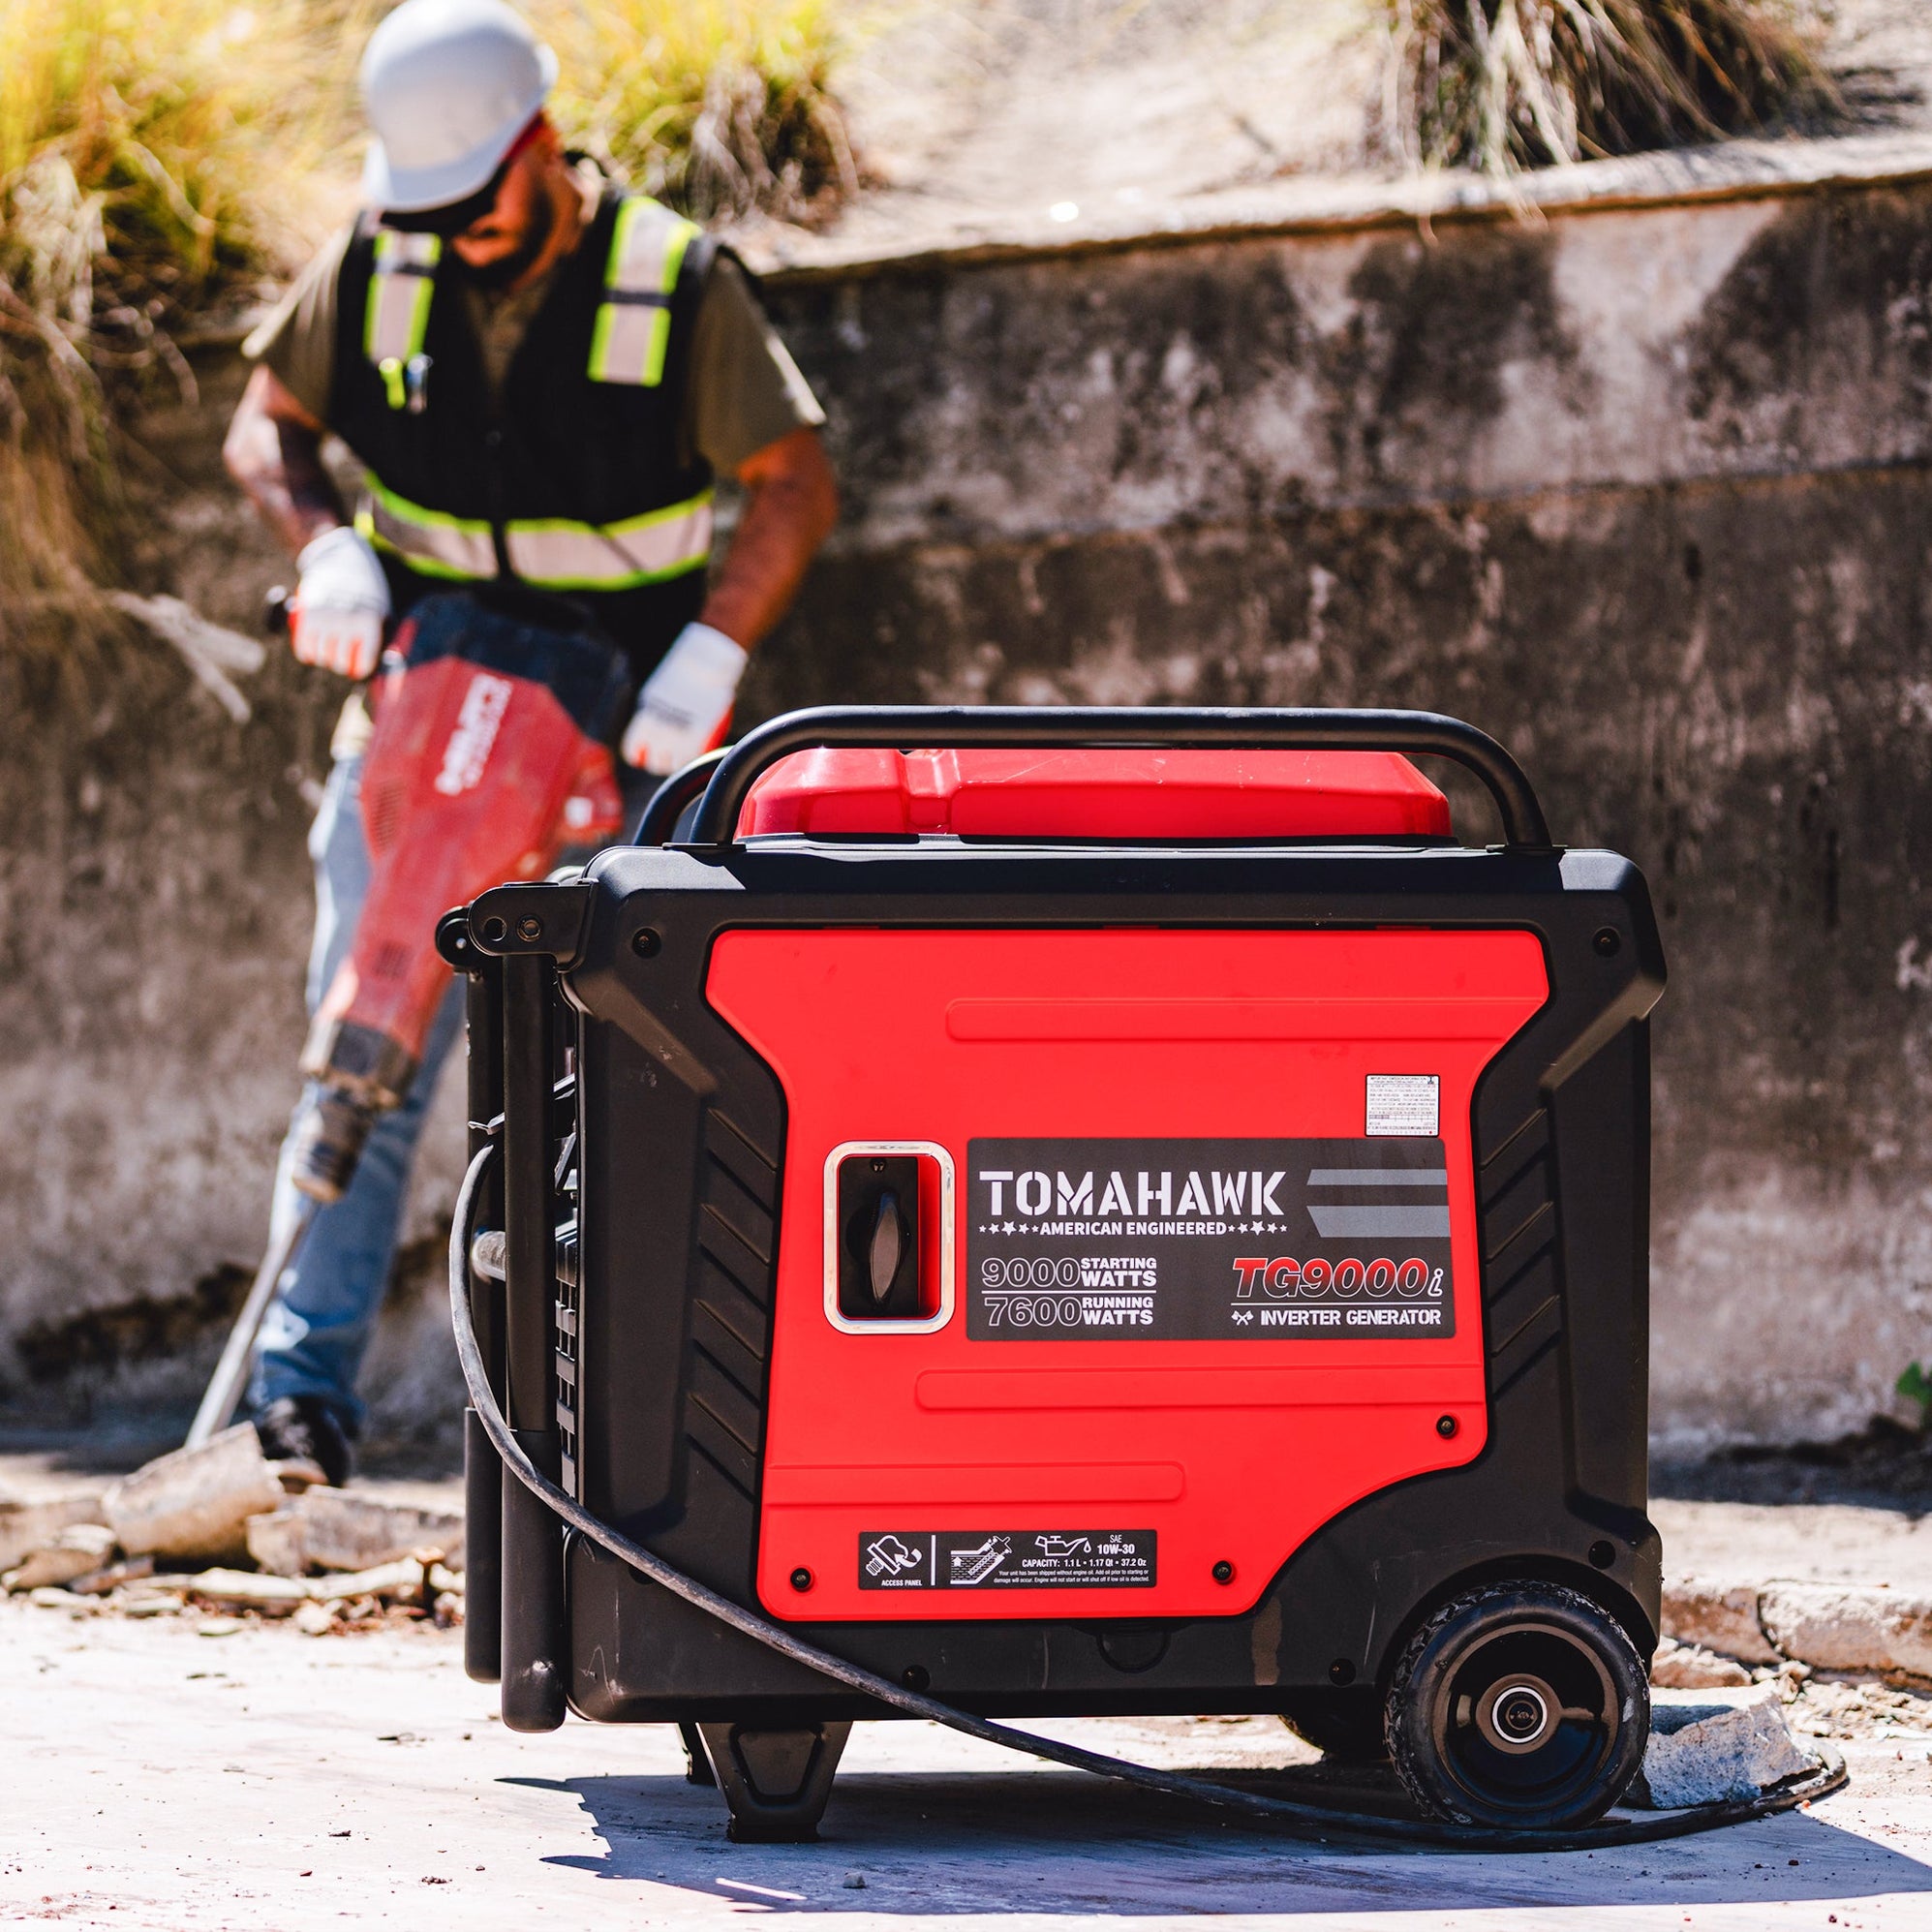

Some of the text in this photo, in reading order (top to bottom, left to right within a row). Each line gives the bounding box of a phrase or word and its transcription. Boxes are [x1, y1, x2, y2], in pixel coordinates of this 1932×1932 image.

[979, 1171, 1286, 1215] TOMAHAWK
[1039, 1221, 1227, 1236] AMERICAN ENGINEERED
[1081, 1257, 1157, 1270] STARTING
[981, 1257, 1081, 1288] 9000
[1081, 1271, 1157, 1287] WATTS
[1232, 1256, 1444, 1299] TG9000i
[1082, 1297, 1153, 1308] RUNNING
[984, 1297, 1083, 1327] 7600
[1082, 1309, 1153, 1325] WATTS
[1260, 1309, 1442, 1326] INVERTER GENERATOR
[1109, 1534, 1122, 1544] SAE
[1096, 1544, 1135, 1554] 10W-30
[1022, 1558, 1060, 1568] CAPACITY:
[1064, 1558, 1075, 1567] 1.1
[1076, 1558, 1082, 1567] L
[1089, 1558, 1104, 1567] 1.17
